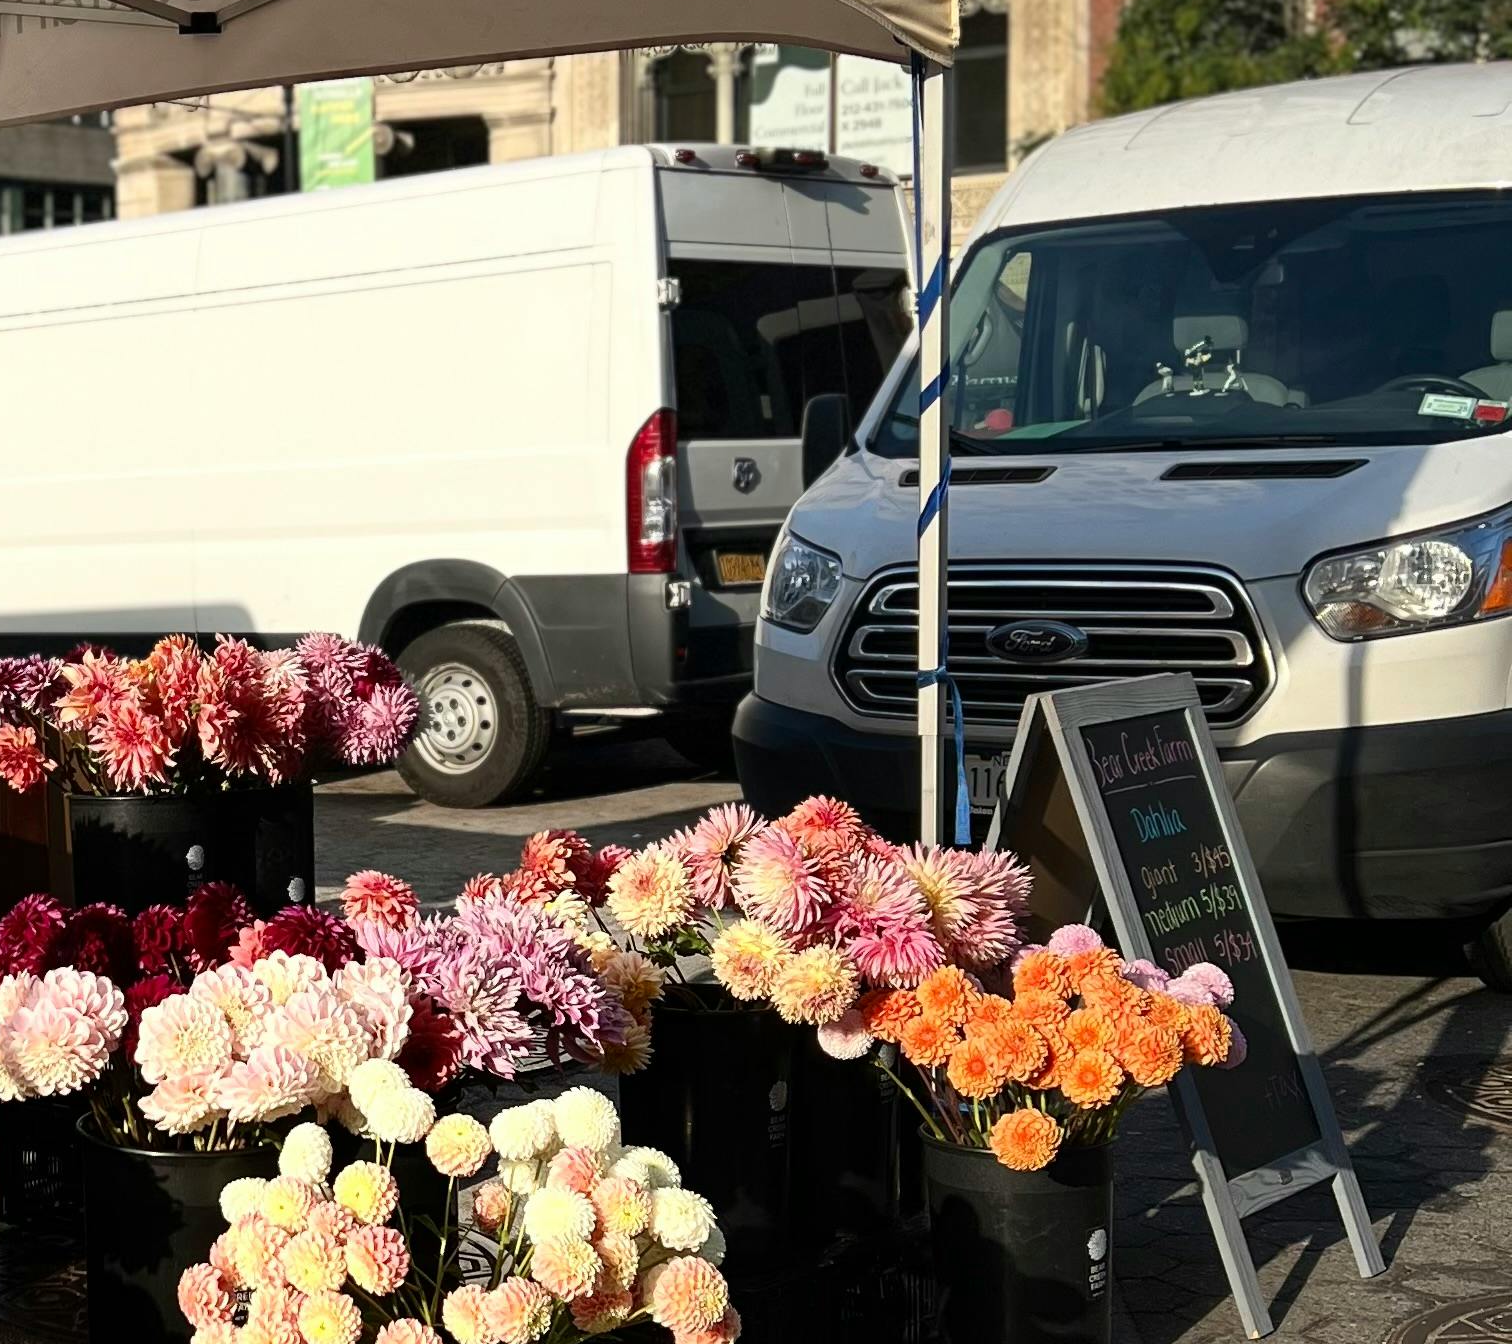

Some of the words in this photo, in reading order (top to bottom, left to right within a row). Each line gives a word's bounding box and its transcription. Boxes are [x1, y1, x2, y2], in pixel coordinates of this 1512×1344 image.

[1086, 737, 1125, 788] Bear
[1120, 731, 1162, 776] Creek
[1152, 724, 1195, 767] Farm
[1128, 800, 1188, 844] Dahlia
